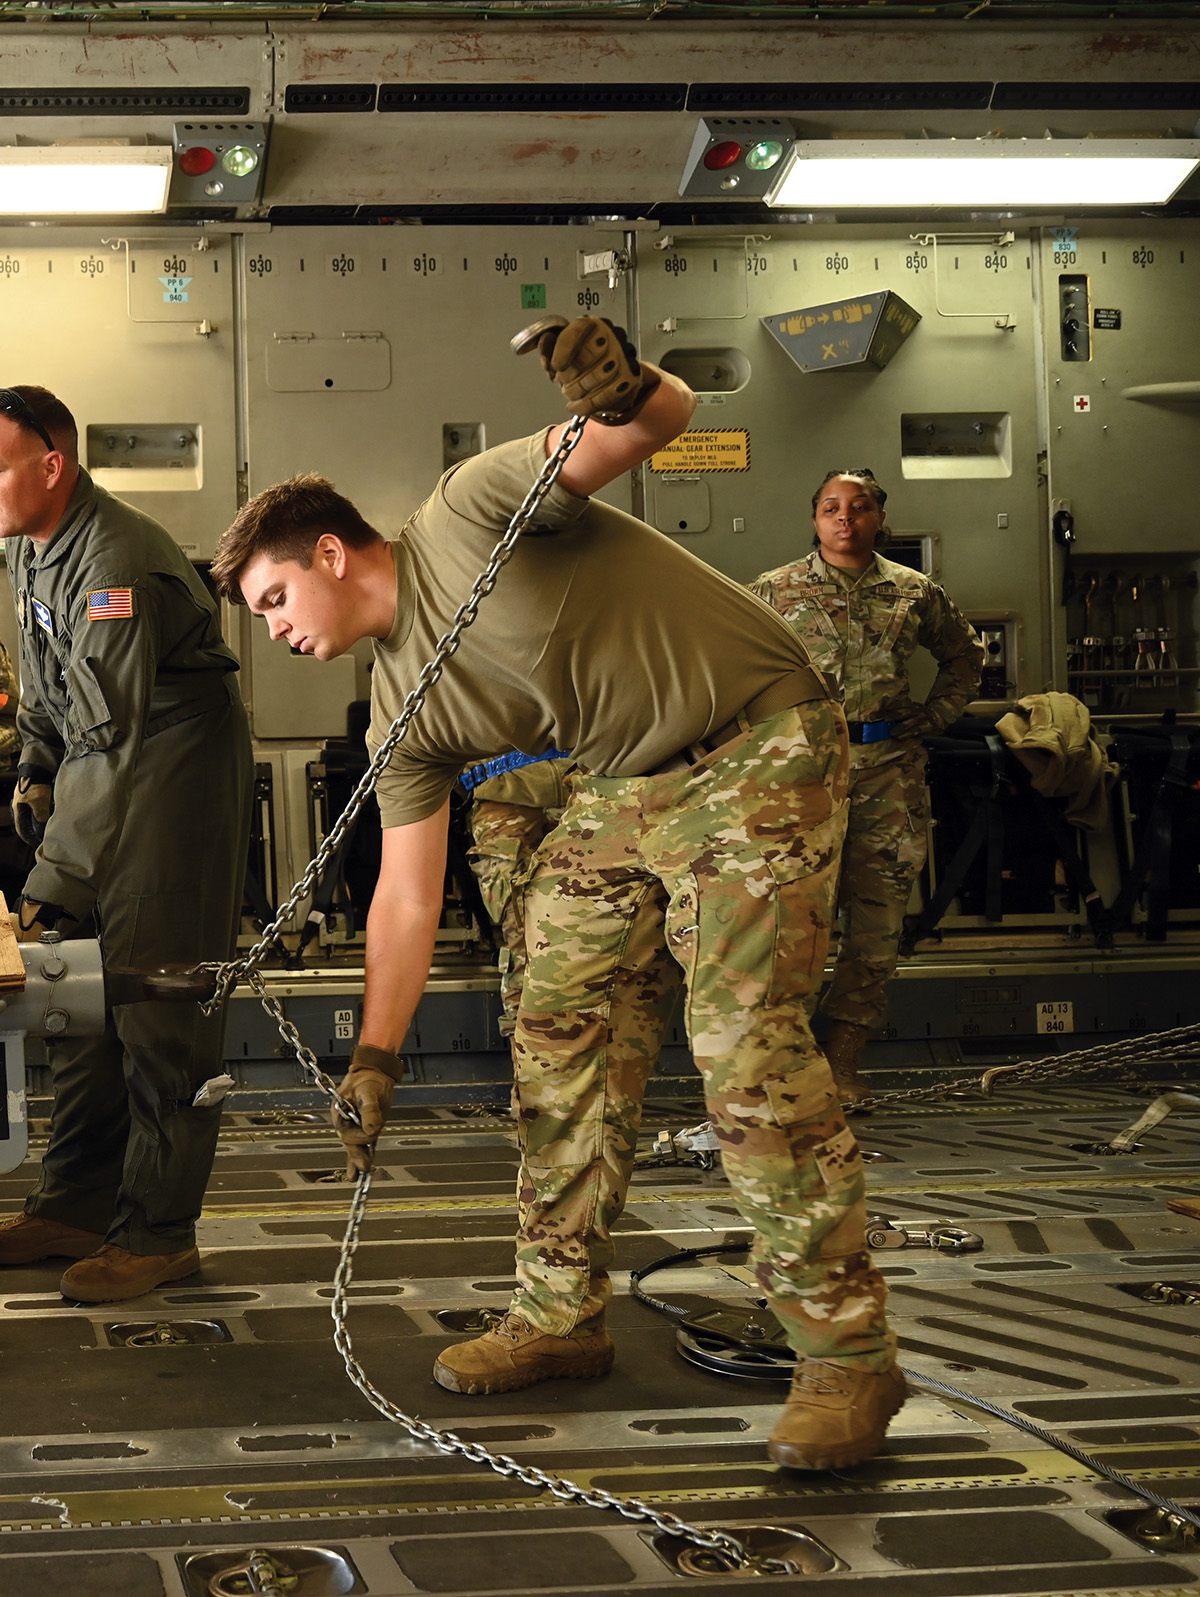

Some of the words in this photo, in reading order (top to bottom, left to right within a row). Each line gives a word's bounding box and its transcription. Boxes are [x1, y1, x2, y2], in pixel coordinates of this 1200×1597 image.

[1058, 243, 1071, 251] 830
[825, 257, 849, 270] 860
[905, 256, 928, 270] 850
[984, 255, 1007, 270] 840
[1053, 251, 1076, 265] 830
[1132, 250, 1154, 265] 820
[80, 259, 104, 273] 950
[163, 259, 187, 273] 940
[249, 258, 272, 273] 930
[332, 258, 355, 272] 920
[413, 257, 436, 272] 910
[495, 257, 517, 272] 900
[664, 258, 687, 272] 880
[169, 294, 183, 302] 940
[577, 292, 600, 306] 890
[679, 435, 718, 443] EMERGENCY
[660, 445, 684, 453] ANUAL
[705, 444, 741, 452] EXTENSION
[800, 587, 824, 597] BROWN
[1041, 1004, 1053, 1015] AD
[1057, 1003, 1068, 1014] 13
[338, 1012, 351, 1022] AD
[338, 1026, 349, 1037] 15
[963, 1023, 980, 1035] 850
[1046, 1021, 1064, 1032] 840
[452, 1038, 471, 1051] 910
